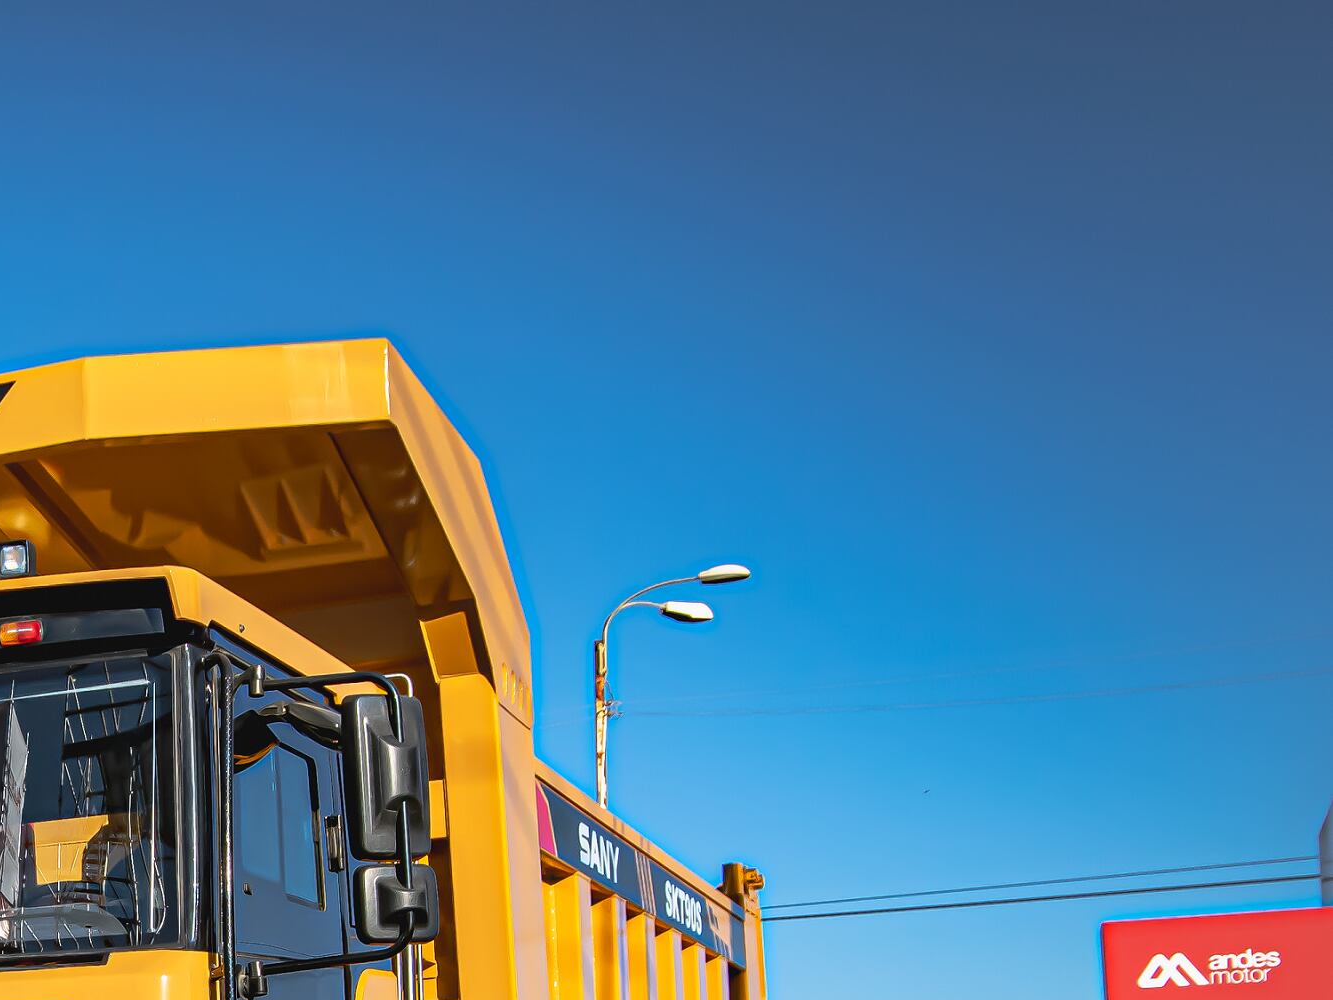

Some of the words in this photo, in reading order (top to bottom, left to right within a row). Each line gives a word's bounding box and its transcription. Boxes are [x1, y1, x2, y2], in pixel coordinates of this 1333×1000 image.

[577, 821, 620, 884] SANY
[664, 879, 703, 936] SKT90S
[1209, 948, 1281, 969] andes
[1209, 967, 1272, 985] motor
